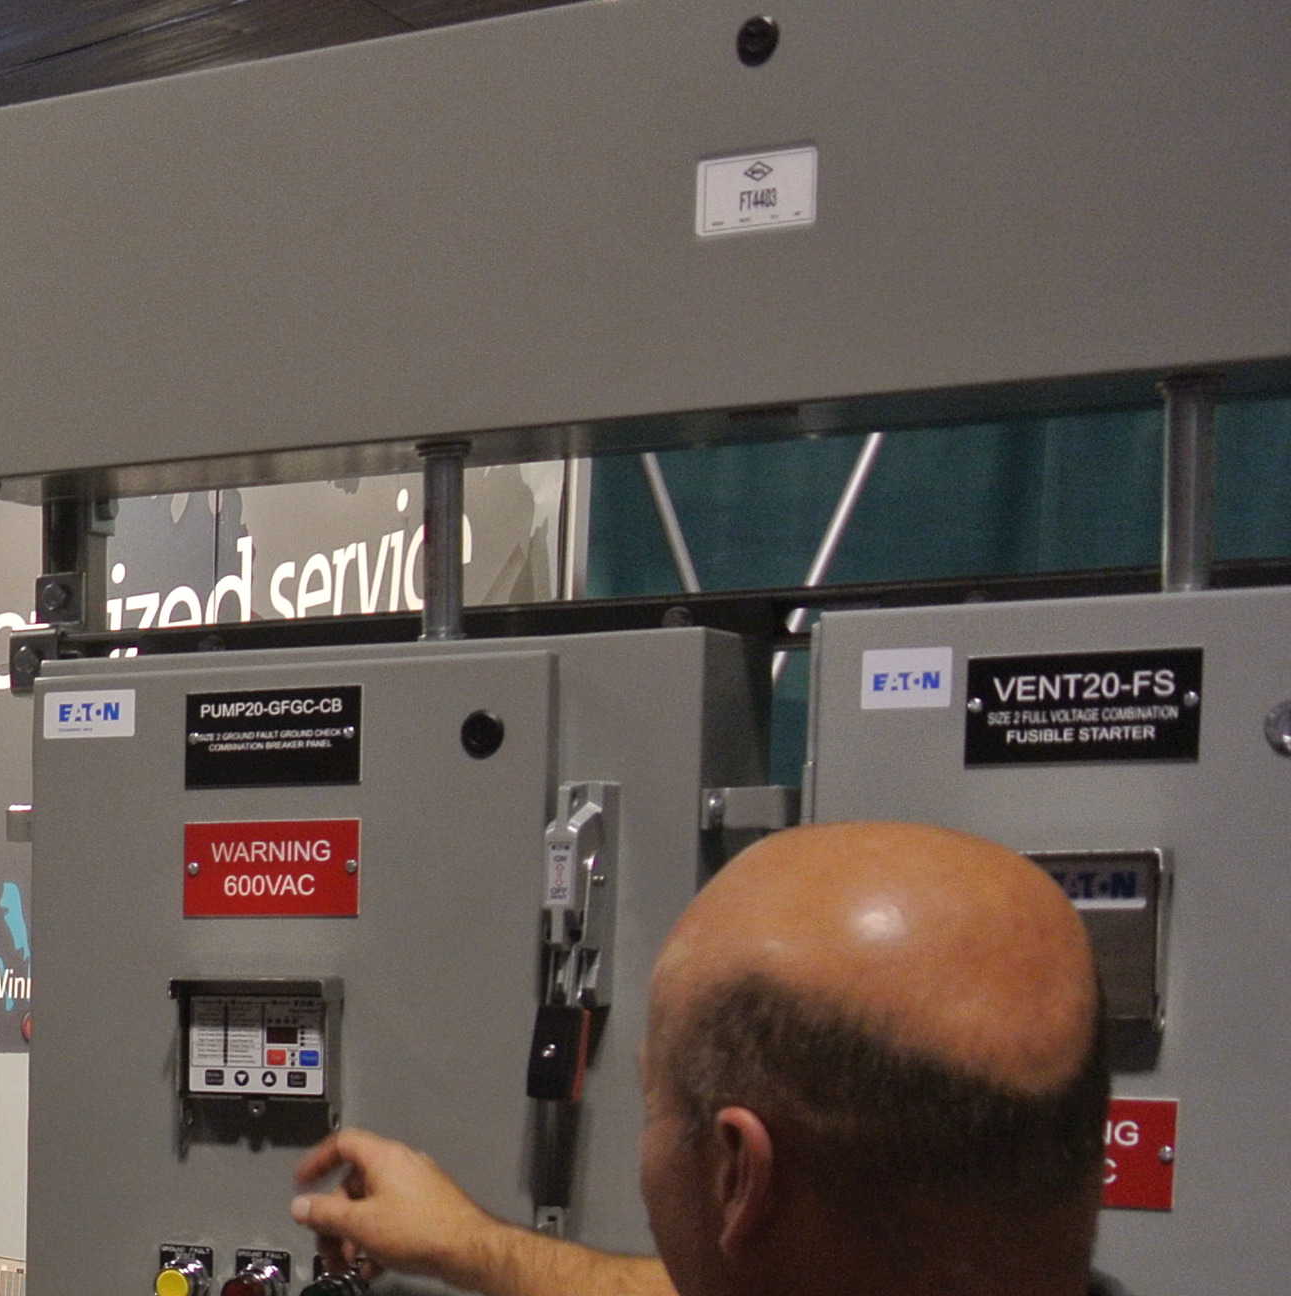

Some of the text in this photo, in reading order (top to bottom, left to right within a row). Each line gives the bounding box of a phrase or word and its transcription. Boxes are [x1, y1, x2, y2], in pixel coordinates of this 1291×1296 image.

[872, 671, 941, 691] EATON
[993, 669, 1176, 702] VENT20-FS
[58, 702, 120, 722] EATON
[199, 698, 343, 719] PUMP20-GFGC-CB
[987, 705, 1179, 726] SIZE 2 FULL VOLTAGE COMBINATION
[222, 731, 255, 741] GROUND
[256, 730, 279, 740] FAULT
[280, 729, 314, 739] GROUND
[315, 728, 342, 737] CHECK
[1006, 725, 1156, 743] FUSIBLE STARTER
[208, 739, 332, 752] COMBINATION BREAKER PANEL
[211, 840, 331, 863] WARNING
[223, 874, 315, 896] 600VAC
